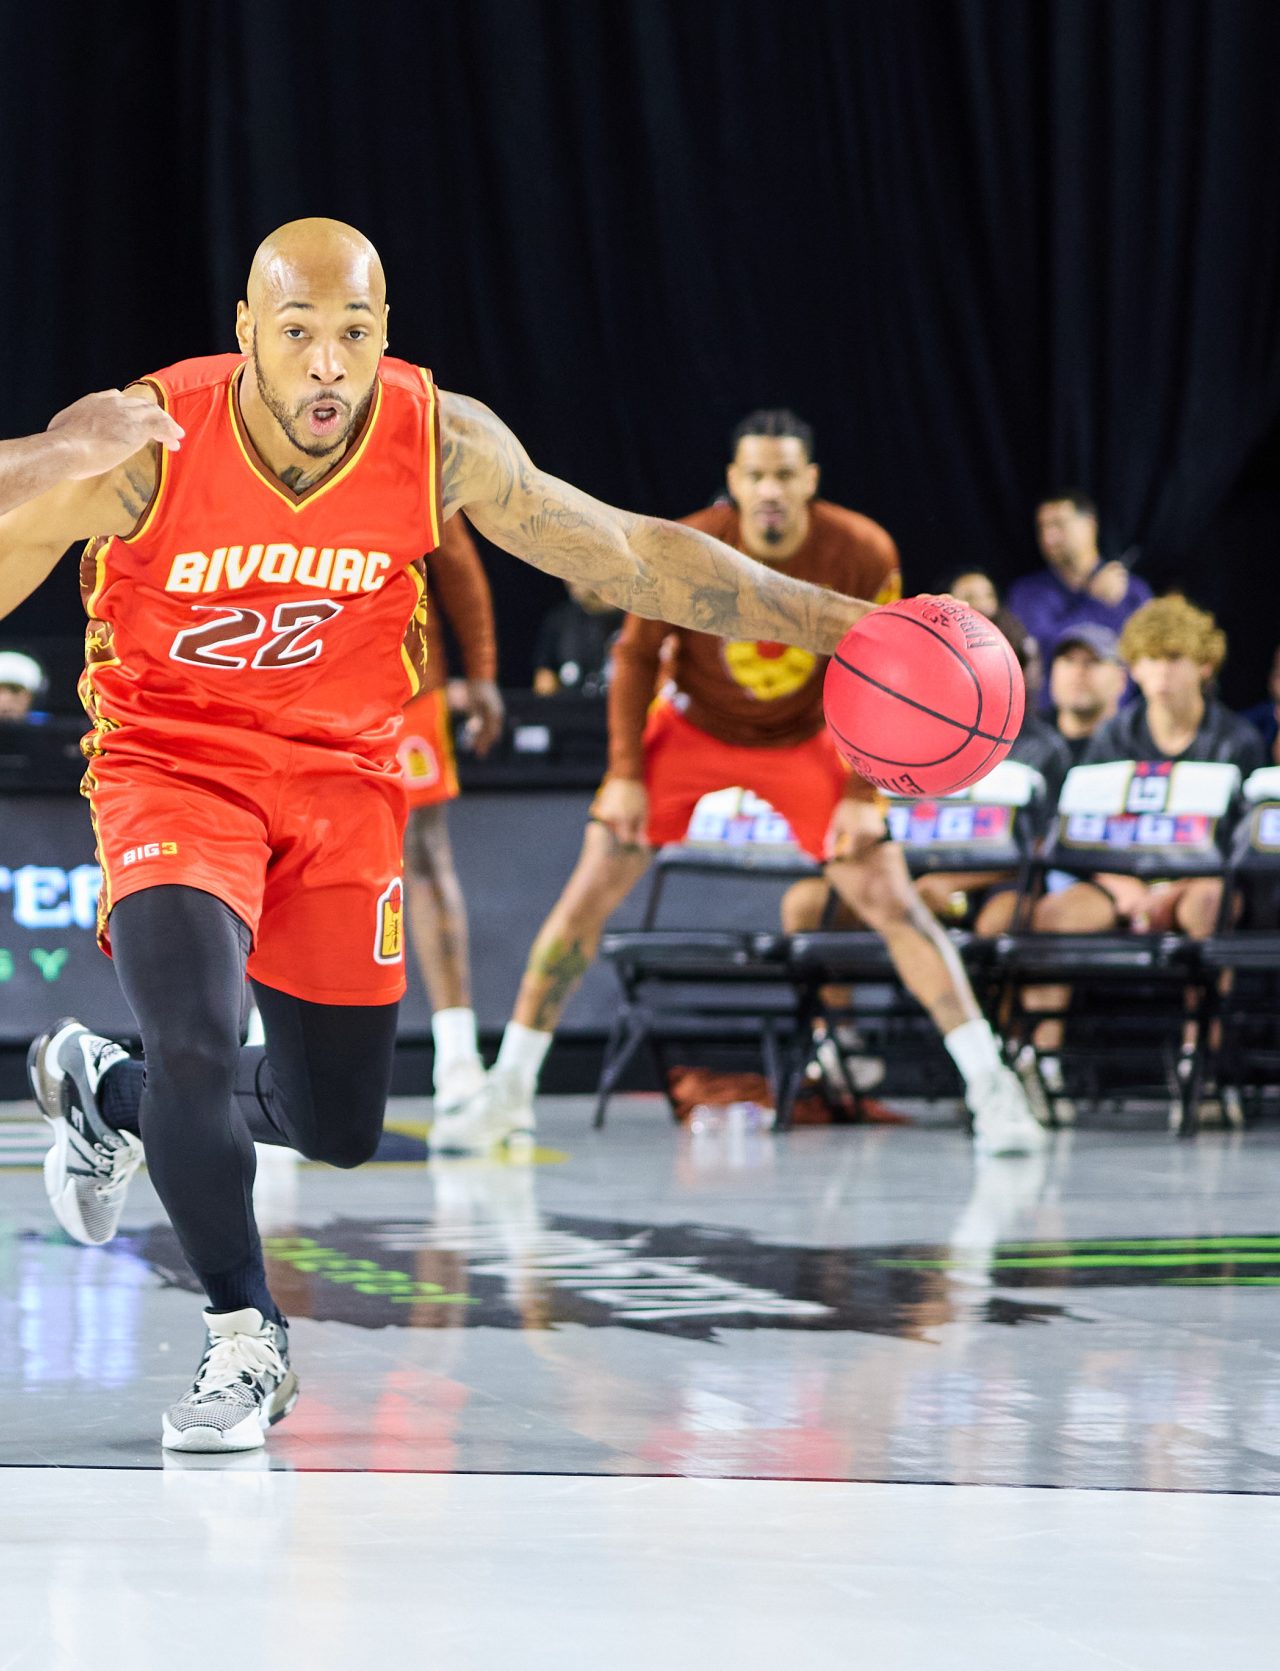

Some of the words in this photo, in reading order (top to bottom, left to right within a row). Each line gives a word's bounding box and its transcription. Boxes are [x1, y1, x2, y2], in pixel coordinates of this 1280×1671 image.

[164, 543, 392, 593] BIVOUAC
[168, 598, 344, 669] 22
[122, 841, 178, 867] BIG3
